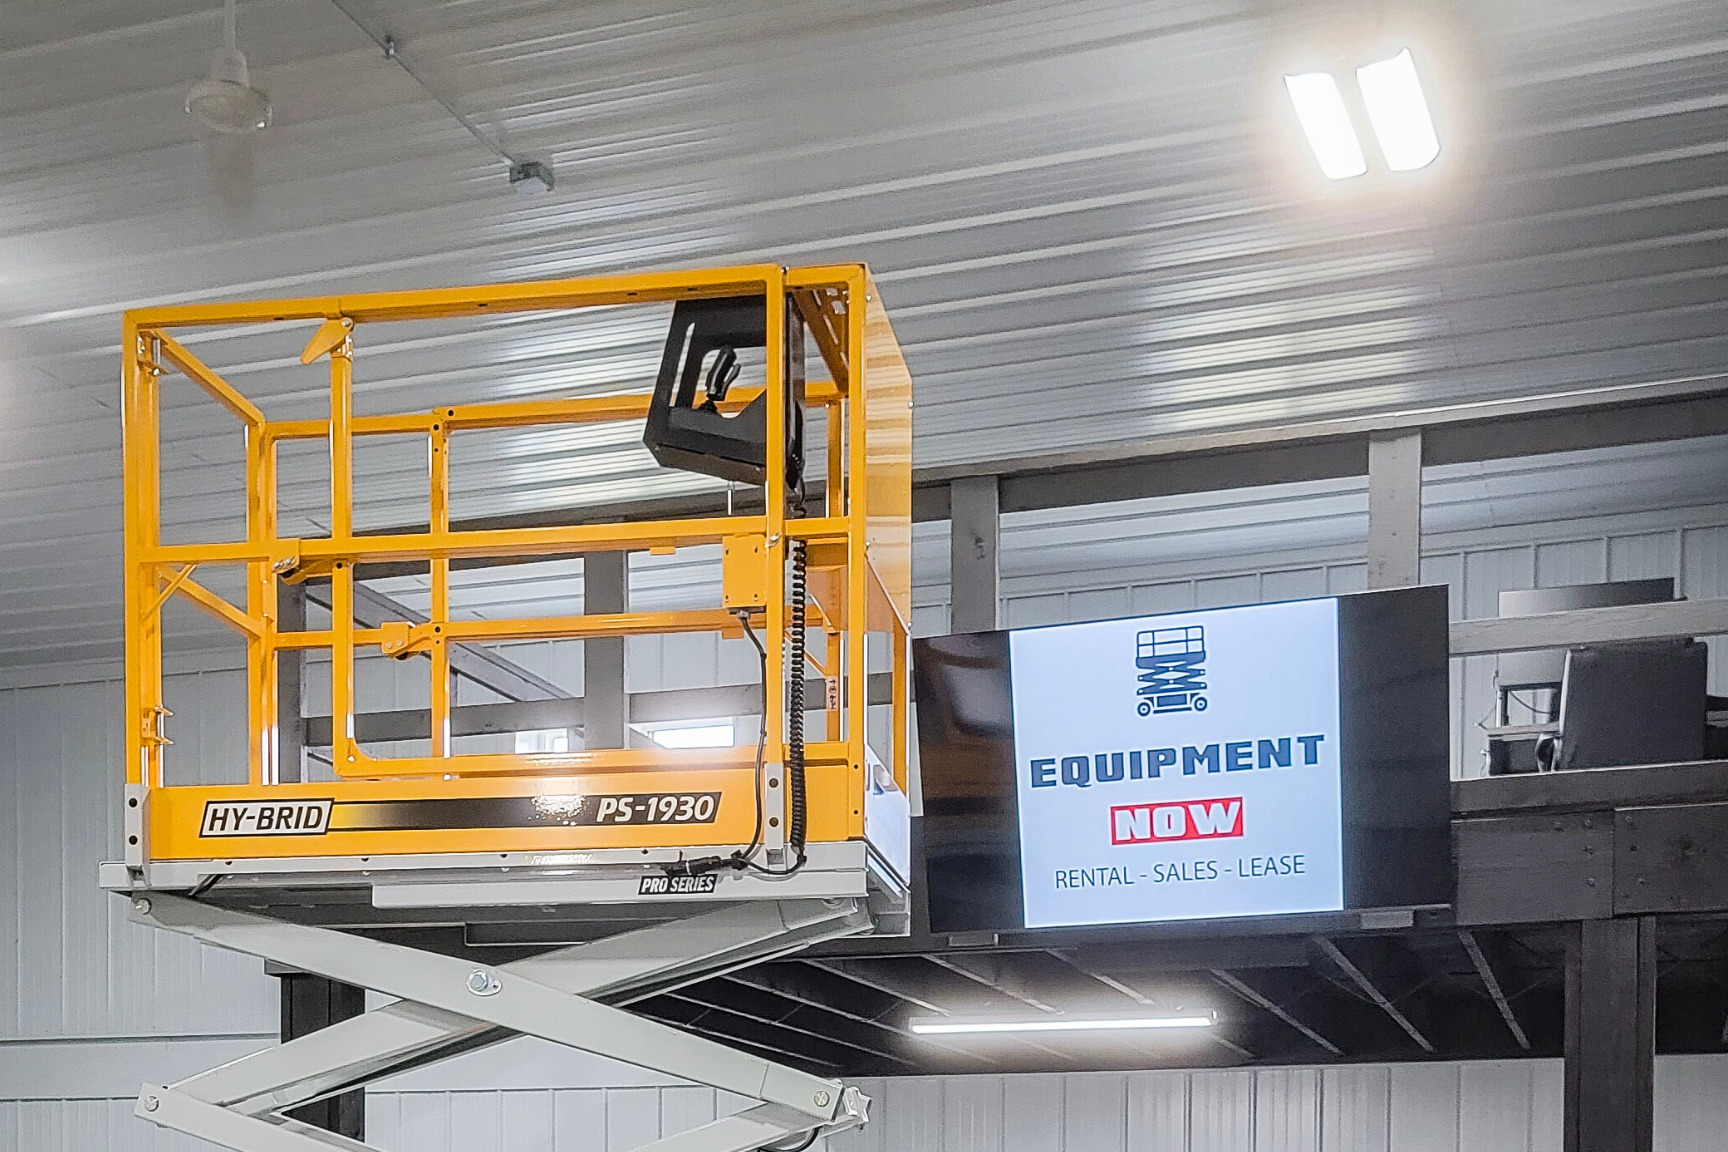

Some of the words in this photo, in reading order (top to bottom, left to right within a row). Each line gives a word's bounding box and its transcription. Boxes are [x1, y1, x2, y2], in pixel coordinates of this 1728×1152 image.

[1029, 734, 1325, 789] EQUIPMENT
[208, 806, 323, 831] HY-BRID
[596, 795, 715, 823] PS-1930
[1114, 801, 1241, 841] NOW
[641, 877, 669, 893] PRO
[670, 876, 715, 893] SERIES
[1055, 867, 1135, 889] RENTAL
[1153, 861, 1218, 883] SALES
[1238, 854, 1306, 878] LEASE
